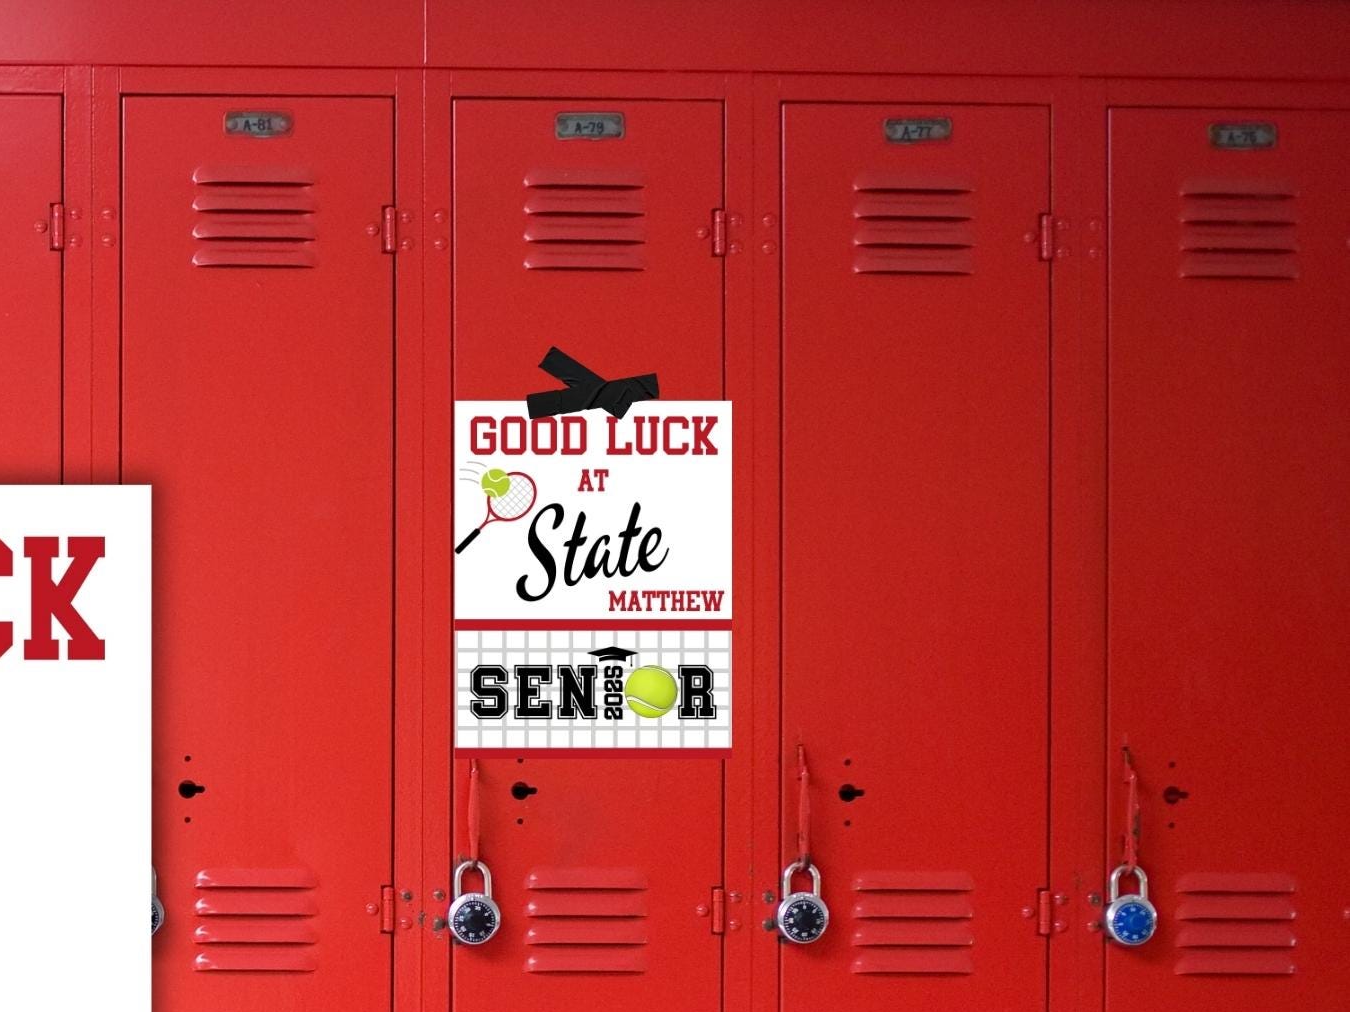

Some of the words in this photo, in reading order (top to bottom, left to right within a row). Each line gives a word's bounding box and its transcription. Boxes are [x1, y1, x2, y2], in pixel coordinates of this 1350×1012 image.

[243, 117, 273, 131] A-81
[574, 121, 605, 134] A-79
[901, 126, 932, 139] A-77
[470, 416, 587, 456] GOOD
[606, 416, 719, 456] LUCK
[577, 469, 609, 492] AT
[516, 502, 670, 602] State
[608, 590, 725, 612] MATTHEW
[603, 665, 624, 720] 2025
